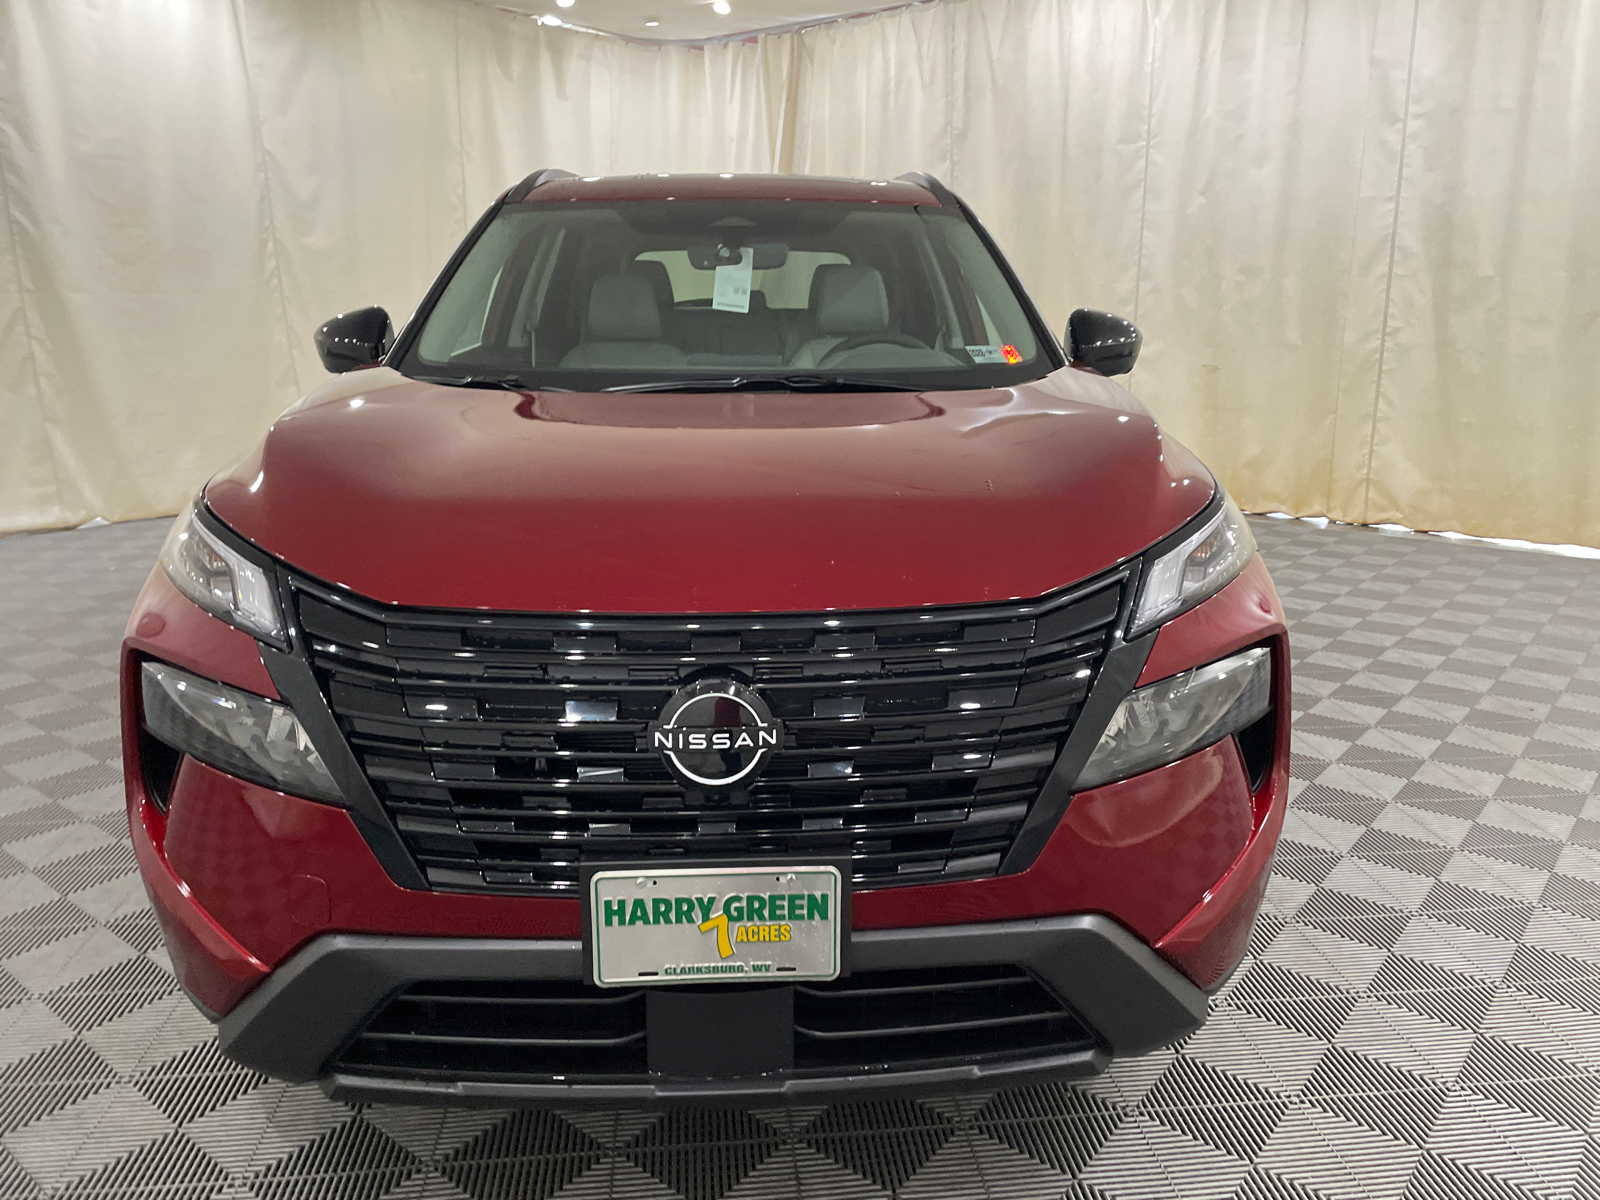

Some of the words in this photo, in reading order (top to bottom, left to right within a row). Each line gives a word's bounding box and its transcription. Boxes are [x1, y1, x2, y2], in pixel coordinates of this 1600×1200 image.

[654, 728, 777, 750] NISSAN
[603, 895, 717, 927] HARRY
[722, 893, 829, 922] GREEN
[698, 913, 734, 959] 7
[736, 923, 791, 943] ACRES
[664, 965, 748, 976] CLARKSBURG,
[752, 964, 771, 973] WV
